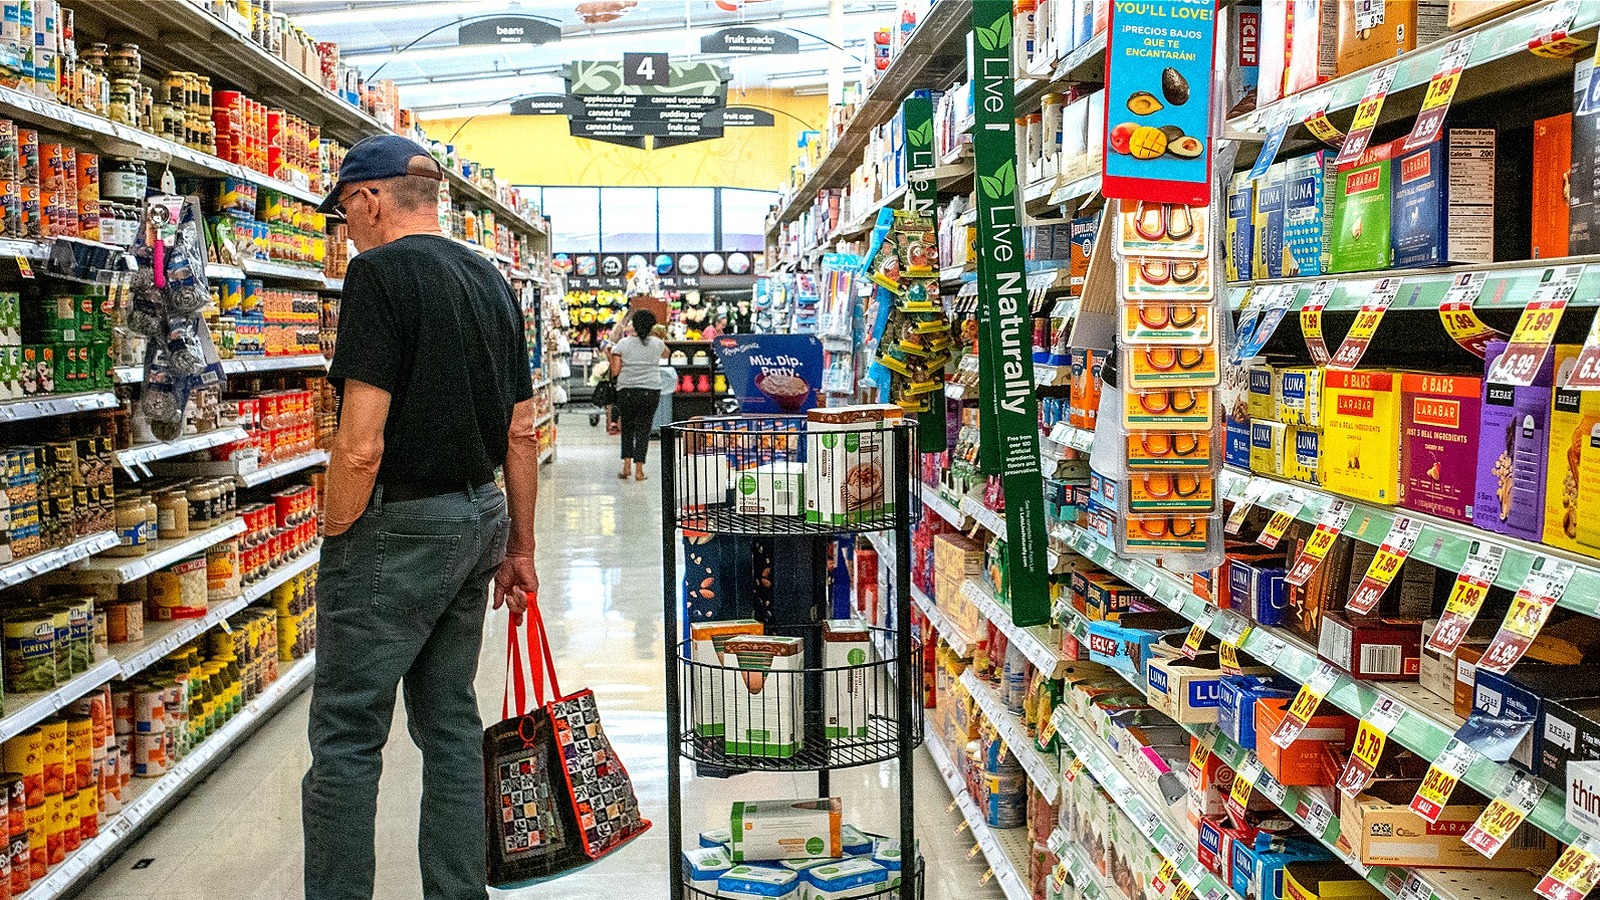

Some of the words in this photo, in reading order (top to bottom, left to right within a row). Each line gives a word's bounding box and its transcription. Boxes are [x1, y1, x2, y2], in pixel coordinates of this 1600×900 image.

[1114, 3, 1166, 17] YOU'LL
[1171, 7, 1213, 20] LOVE!
[496, 26, 524, 35] beans
[1122, 26, 1167, 36] ¡PRECIOS
[1169, 29, 1202, 39] BAJOS
[724, 34, 744, 44] fruit
[746, 35, 775, 44] snacks
[1144, 38, 1165, 48] QUE
[1167, 40, 1180, 48] TE
[1242, 25, 1256, 63] CLIF
[1125, 47, 1196, 61] ENCANTARÁN!
[636, 56, 655, 80] 4
[984, 58, 1009, 113] Live
[1430, 78, 1453, 99] 7.99
[531, 101, 563, 109] tomatoes
[583, 96, 622, 104] applesauce
[623, 96, 636, 104] jars
[678, 97, 715, 105] vegetables
[660, 111, 689, 119] pudding
[1359, 101, 1377, 120] 7.99
[914, 151, 932, 191] Lie
[1348, 172, 1377, 189] LARABAR
[1260, 190, 1280, 206] LUNA
[1289, 182, 1312, 200] LUNA
[1230, 198, 1245, 211] LUNA
[991, 205, 1017, 262] Live
[1355, 314, 1376, 329] 7.99
[1445, 314, 1475, 330] 7.99
[1522, 313, 1554, 331] 7.99
[996, 271, 1030, 415] Naturally
[749, 355, 777, 366] Mix.
[777, 355, 803, 367] Dip.
[1337, 346, 1358, 362] 6.99
[761, 367, 799, 378] Party.
[1505, 354, 1535, 375] 6.99
[1251, 373, 1269, 388] LUNA
[1284, 377, 1304, 391] LUNA
[1343, 375, 1348, 387] 8
[1351, 375, 1370, 388] BARS
[1422, 378, 1428, 391] 8
[1430, 378, 1453, 393] BARS
[1340, 398, 1371, 411] LARABAR
[1417, 404, 1455, 419] LARABAR
[1254, 426, 1269, 442] LUNA
[1421, 430, 1433, 439] REAL
[1434, 432, 1467, 443] INGREDIENTS
[1298, 436, 1316, 450] LUNA
[1311, 533, 1331, 549] 7.99
[1293, 562, 1313, 579] 6.99
[1375, 554, 1398, 573] 7.99
[1233, 571, 1246, 583] LUNA
[1356, 587, 1377, 605] 6.99
[1455, 585, 1480, 607] 7.99
[1436, 623, 1461, 645] 6.99
[23, 643, 49, 652] GREEN
[1490, 642, 1518, 664] 6.99
[1150, 669, 1166, 687] LUNA
[1221, 686, 1233, 703] LUNA
[1294, 690, 1317, 718] 9.79
[1549, 724, 1571, 742] RXBAR
[1358, 728, 1380, 763] 9.79
[1424, 768, 1454, 797] 3/5.00
[1417, 800, 1432, 814] SALE
[1430, 823, 1470, 831] LARA
[1202, 827, 1218, 846] LUNA
[1236, 849, 1251, 872] LUNA
